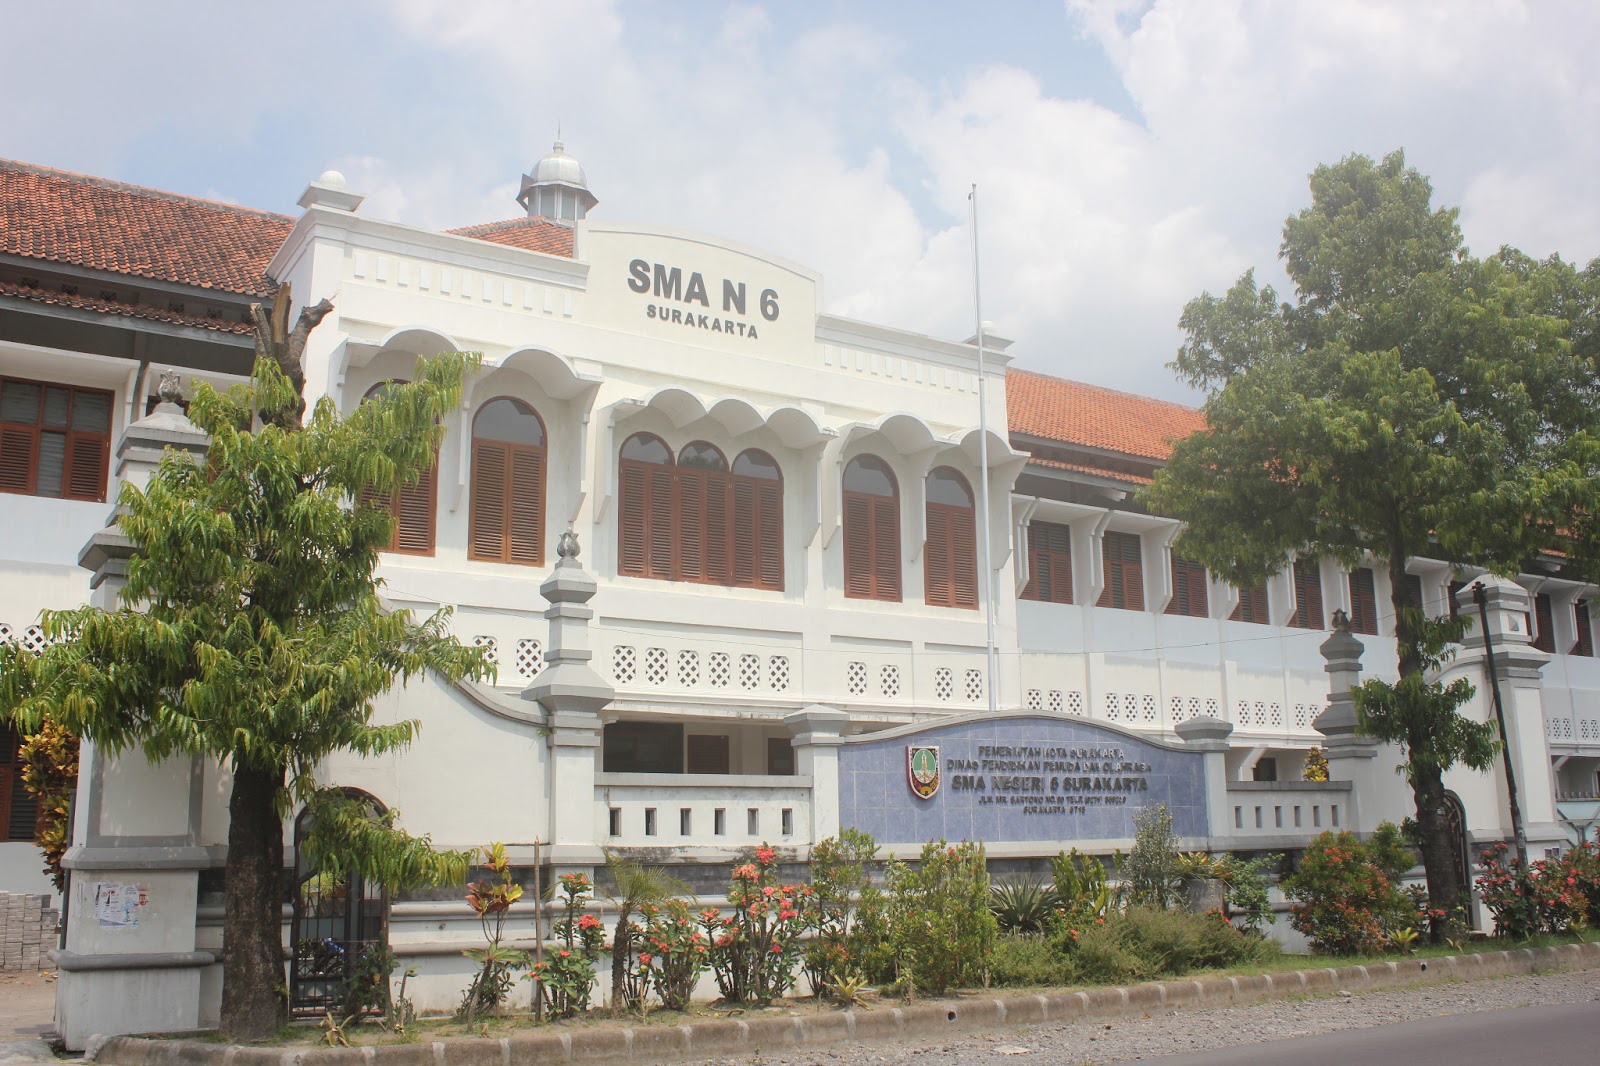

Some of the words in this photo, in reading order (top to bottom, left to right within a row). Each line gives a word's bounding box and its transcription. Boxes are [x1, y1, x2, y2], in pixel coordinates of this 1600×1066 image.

[627, 259, 710, 307] SMA
[722, 278, 746, 315] N
[760, 288, 780, 321] 6
[647, 304, 758, 339] SURAKARTA
[978, 746, 1041, 758] PEMERINTAH
[1043, 747, 1067, 758] KOTA
[1070, 748, 1125, 759] SURAKARTA
[947, 759, 978, 770] DINAS
[981, 760, 1041, 771] PENDIDIKAN
[1043, 761, 1080, 772] PEMUDA
[952, 775, 986, 790] SMA
[991, 776, 1045, 790] NEGERI
[1050, 776, 1059, 791] 6
[1062, 777, 1148, 791] SURAKARTA
